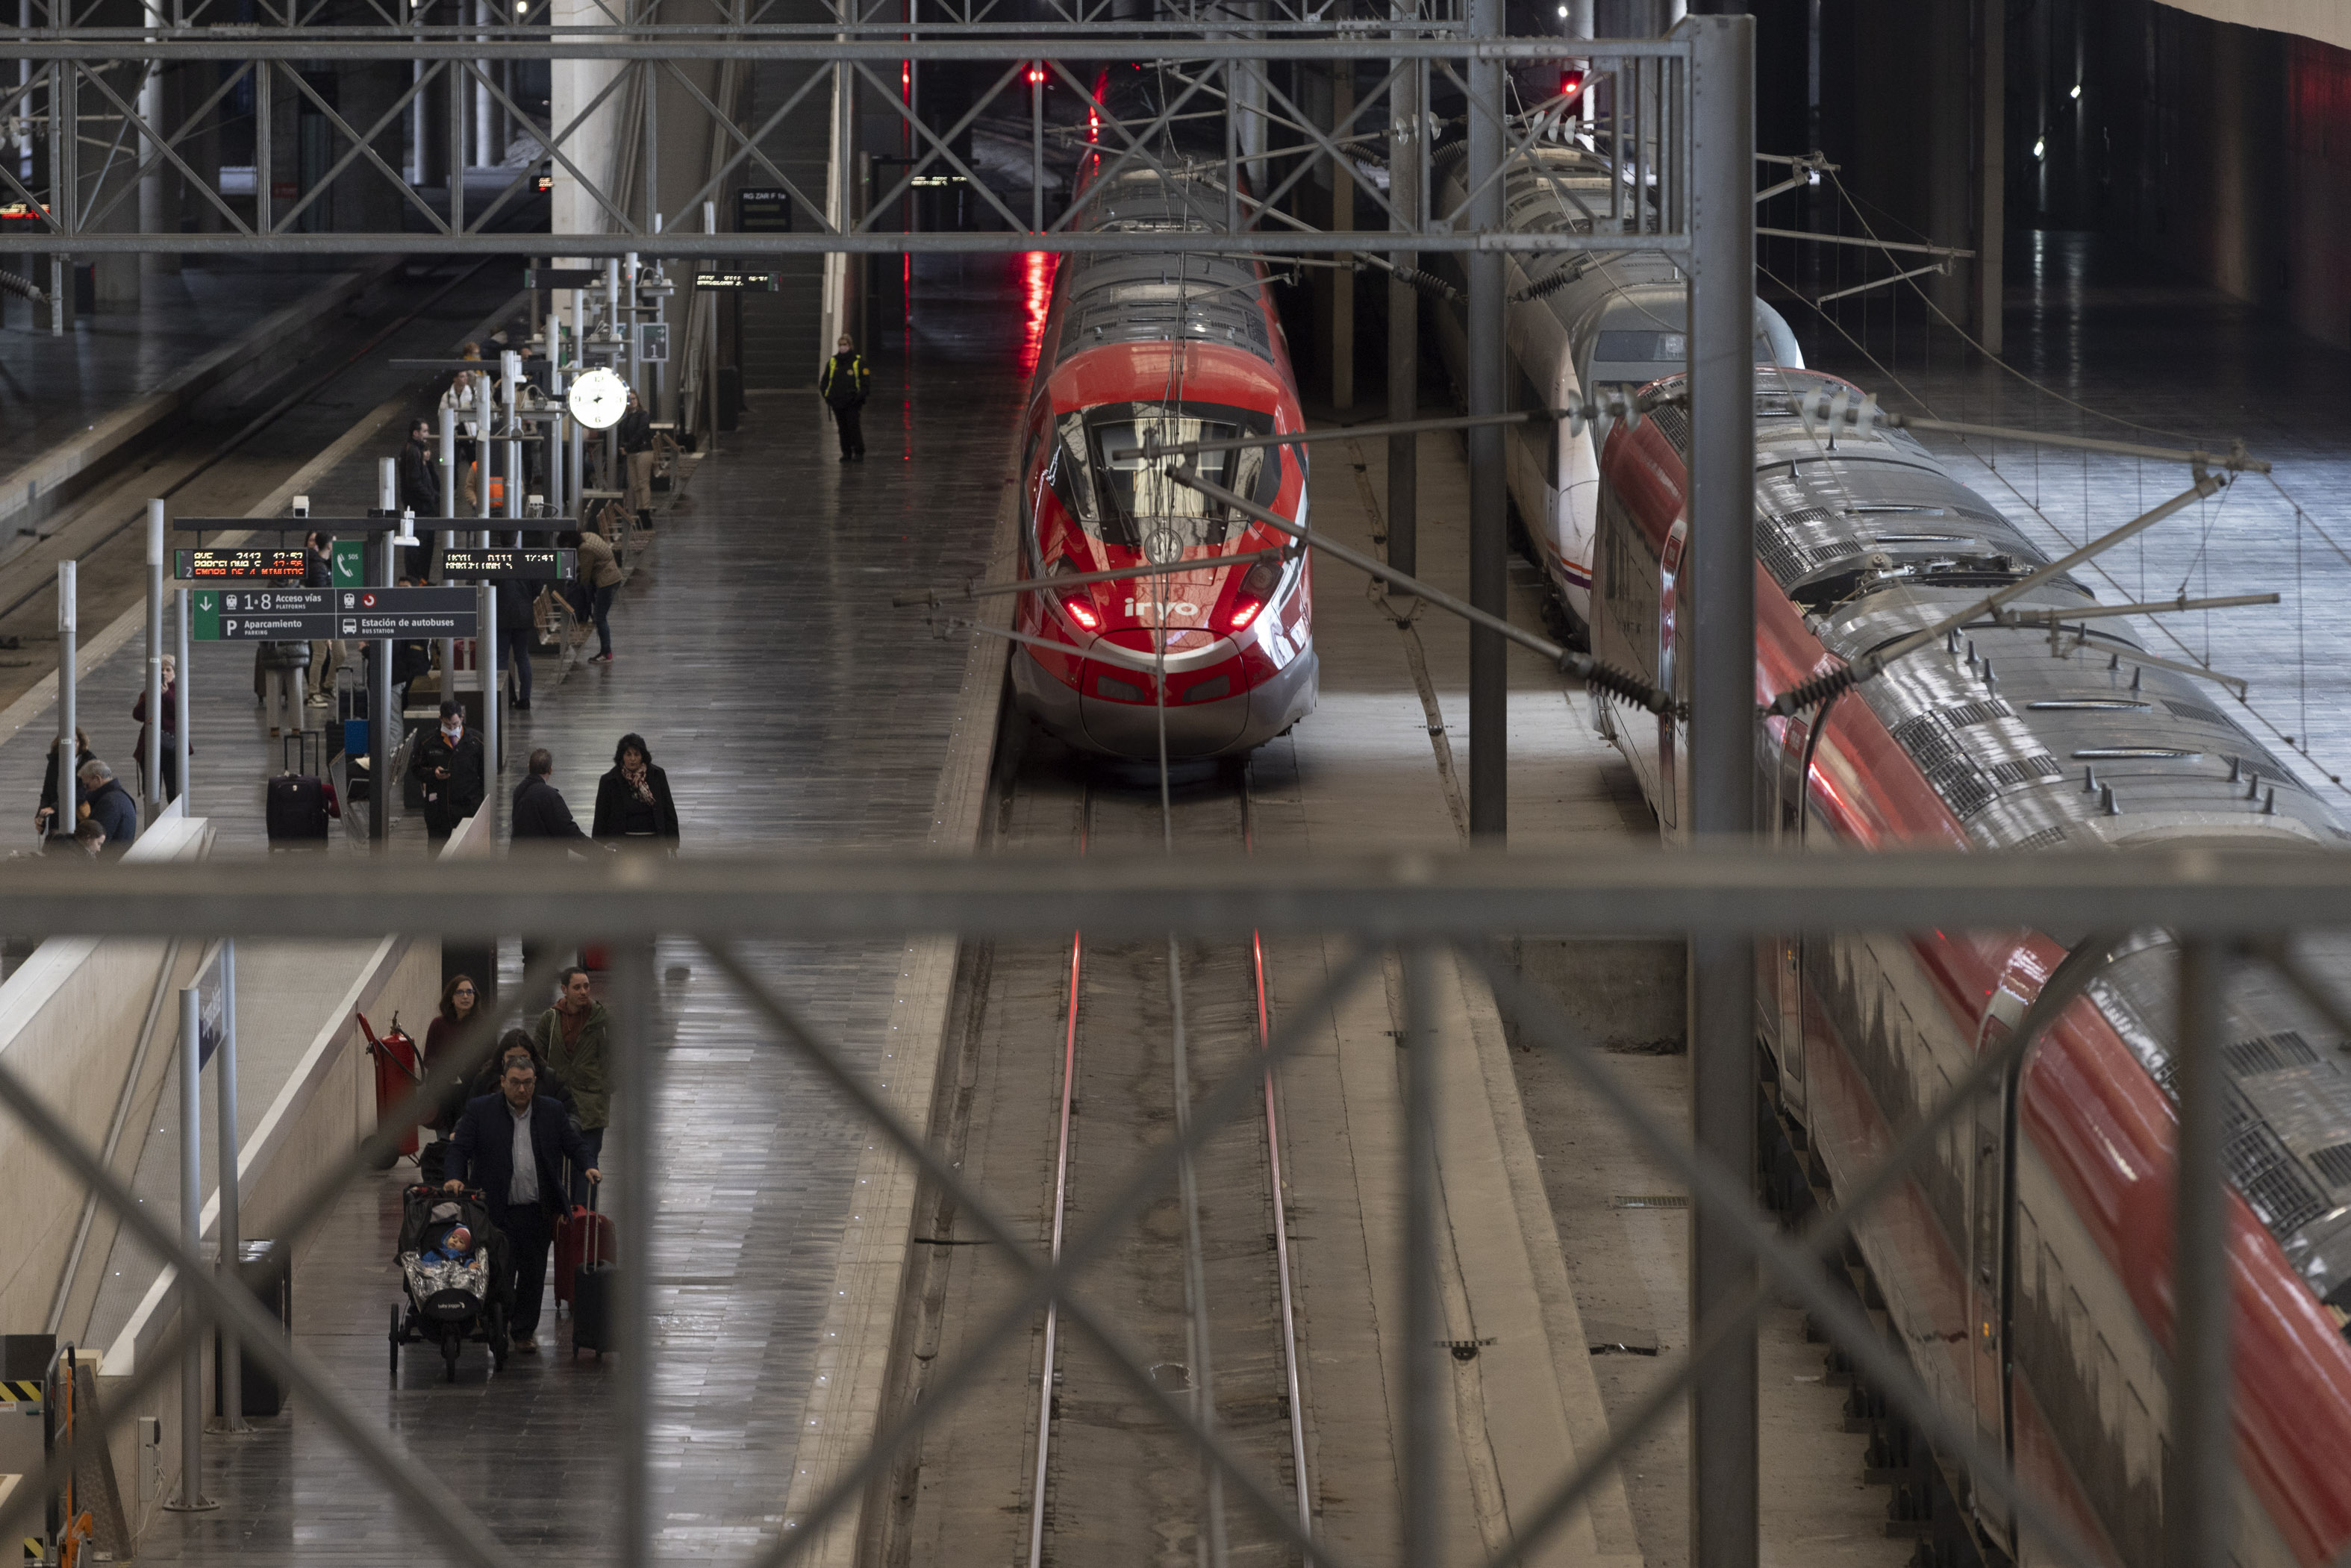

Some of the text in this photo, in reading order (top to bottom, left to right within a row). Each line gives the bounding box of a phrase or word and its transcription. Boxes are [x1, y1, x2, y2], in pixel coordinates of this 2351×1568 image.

[650, 344, 658, 358] 1
[185, 566, 193, 578] 2
[565, 566, 573, 578] 1
[275, 593, 322, 603] Acceso vías
[1124, 597, 1199, 621] iryo
[244, 619, 302, 630] Aparcamiento
[361, 618, 455, 628] Estación de autobuses
